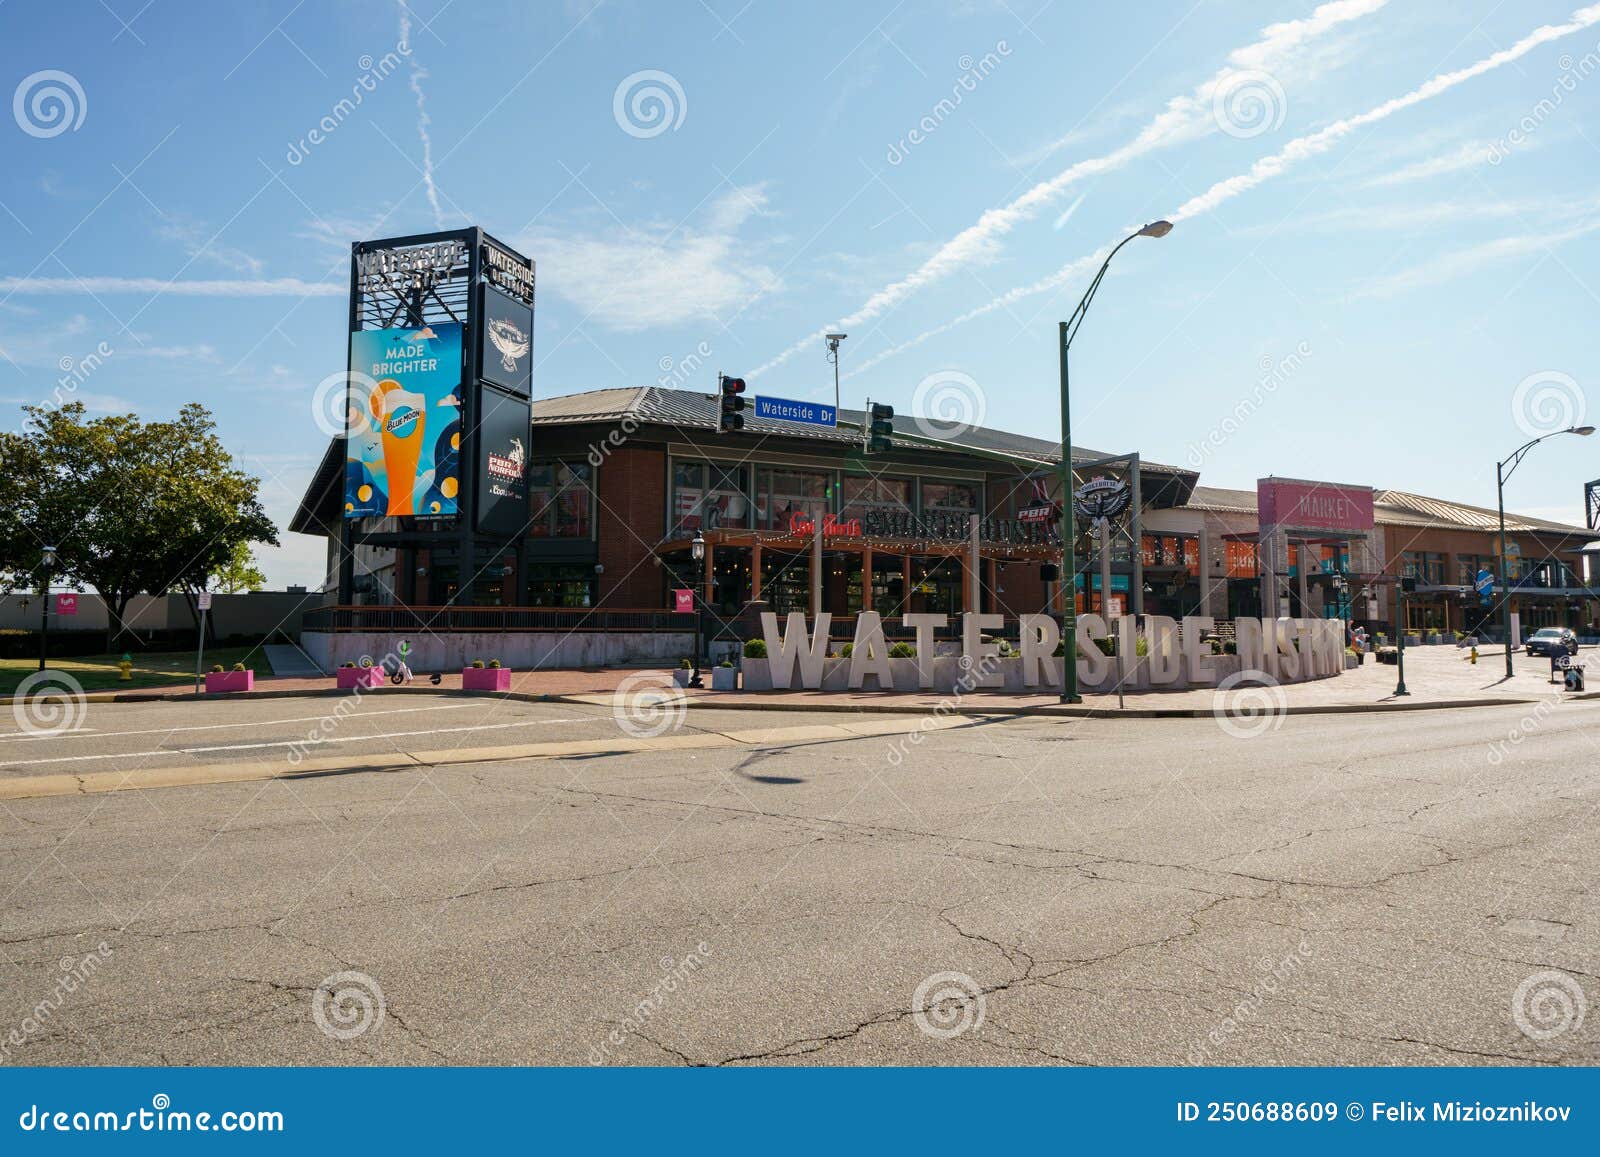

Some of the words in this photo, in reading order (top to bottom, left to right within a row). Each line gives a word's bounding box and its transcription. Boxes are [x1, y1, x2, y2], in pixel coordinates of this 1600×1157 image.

[356, 240, 465, 276] WATERSIDE
[488, 246, 535, 287] WATERSIDE
[386, 344, 425, 360] MADE
[372, 359, 438, 376] BRIGHTER
[386, 416, 404, 431] BLUE
[403, 408, 420, 422] MOON
[761, 402, 813, 419] Waterside
[821, 410, 833, 422] Dr
[489, 456, 512, 469] PBR
[1018, 507, 1050, 520] PBR
[1300, 495, 1351, 519] MARKET
[760, 611, 1215, 689] WATERSIDE
